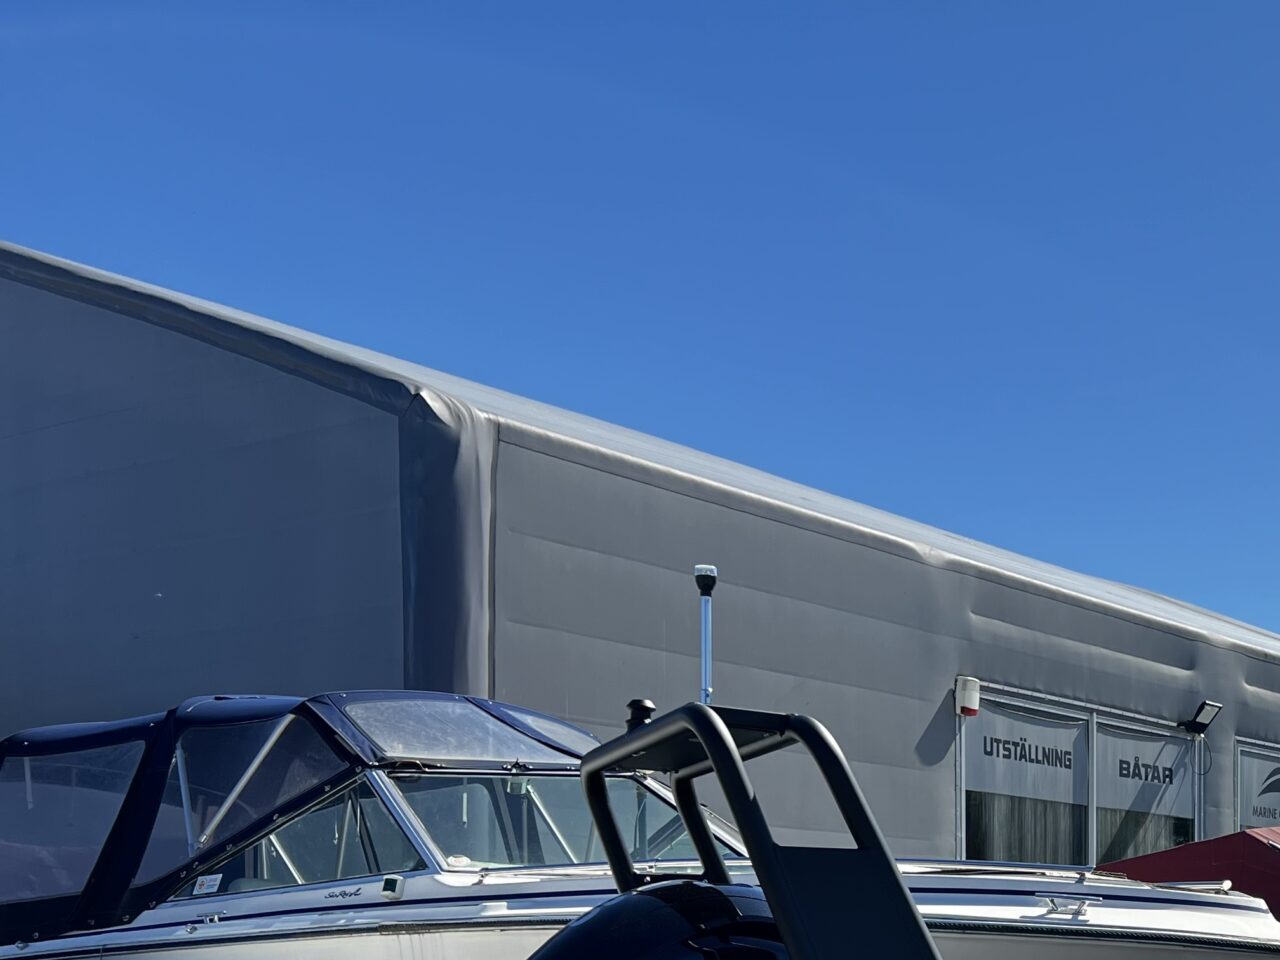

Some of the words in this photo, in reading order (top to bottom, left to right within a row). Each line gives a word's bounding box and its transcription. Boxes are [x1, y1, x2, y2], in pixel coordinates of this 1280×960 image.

[983, 736, 1072, 769] UTSTÄLLNING
[1118, 756, 1174, 785] BÅTAR
[1252, 805, 1277, 820] MARINE
